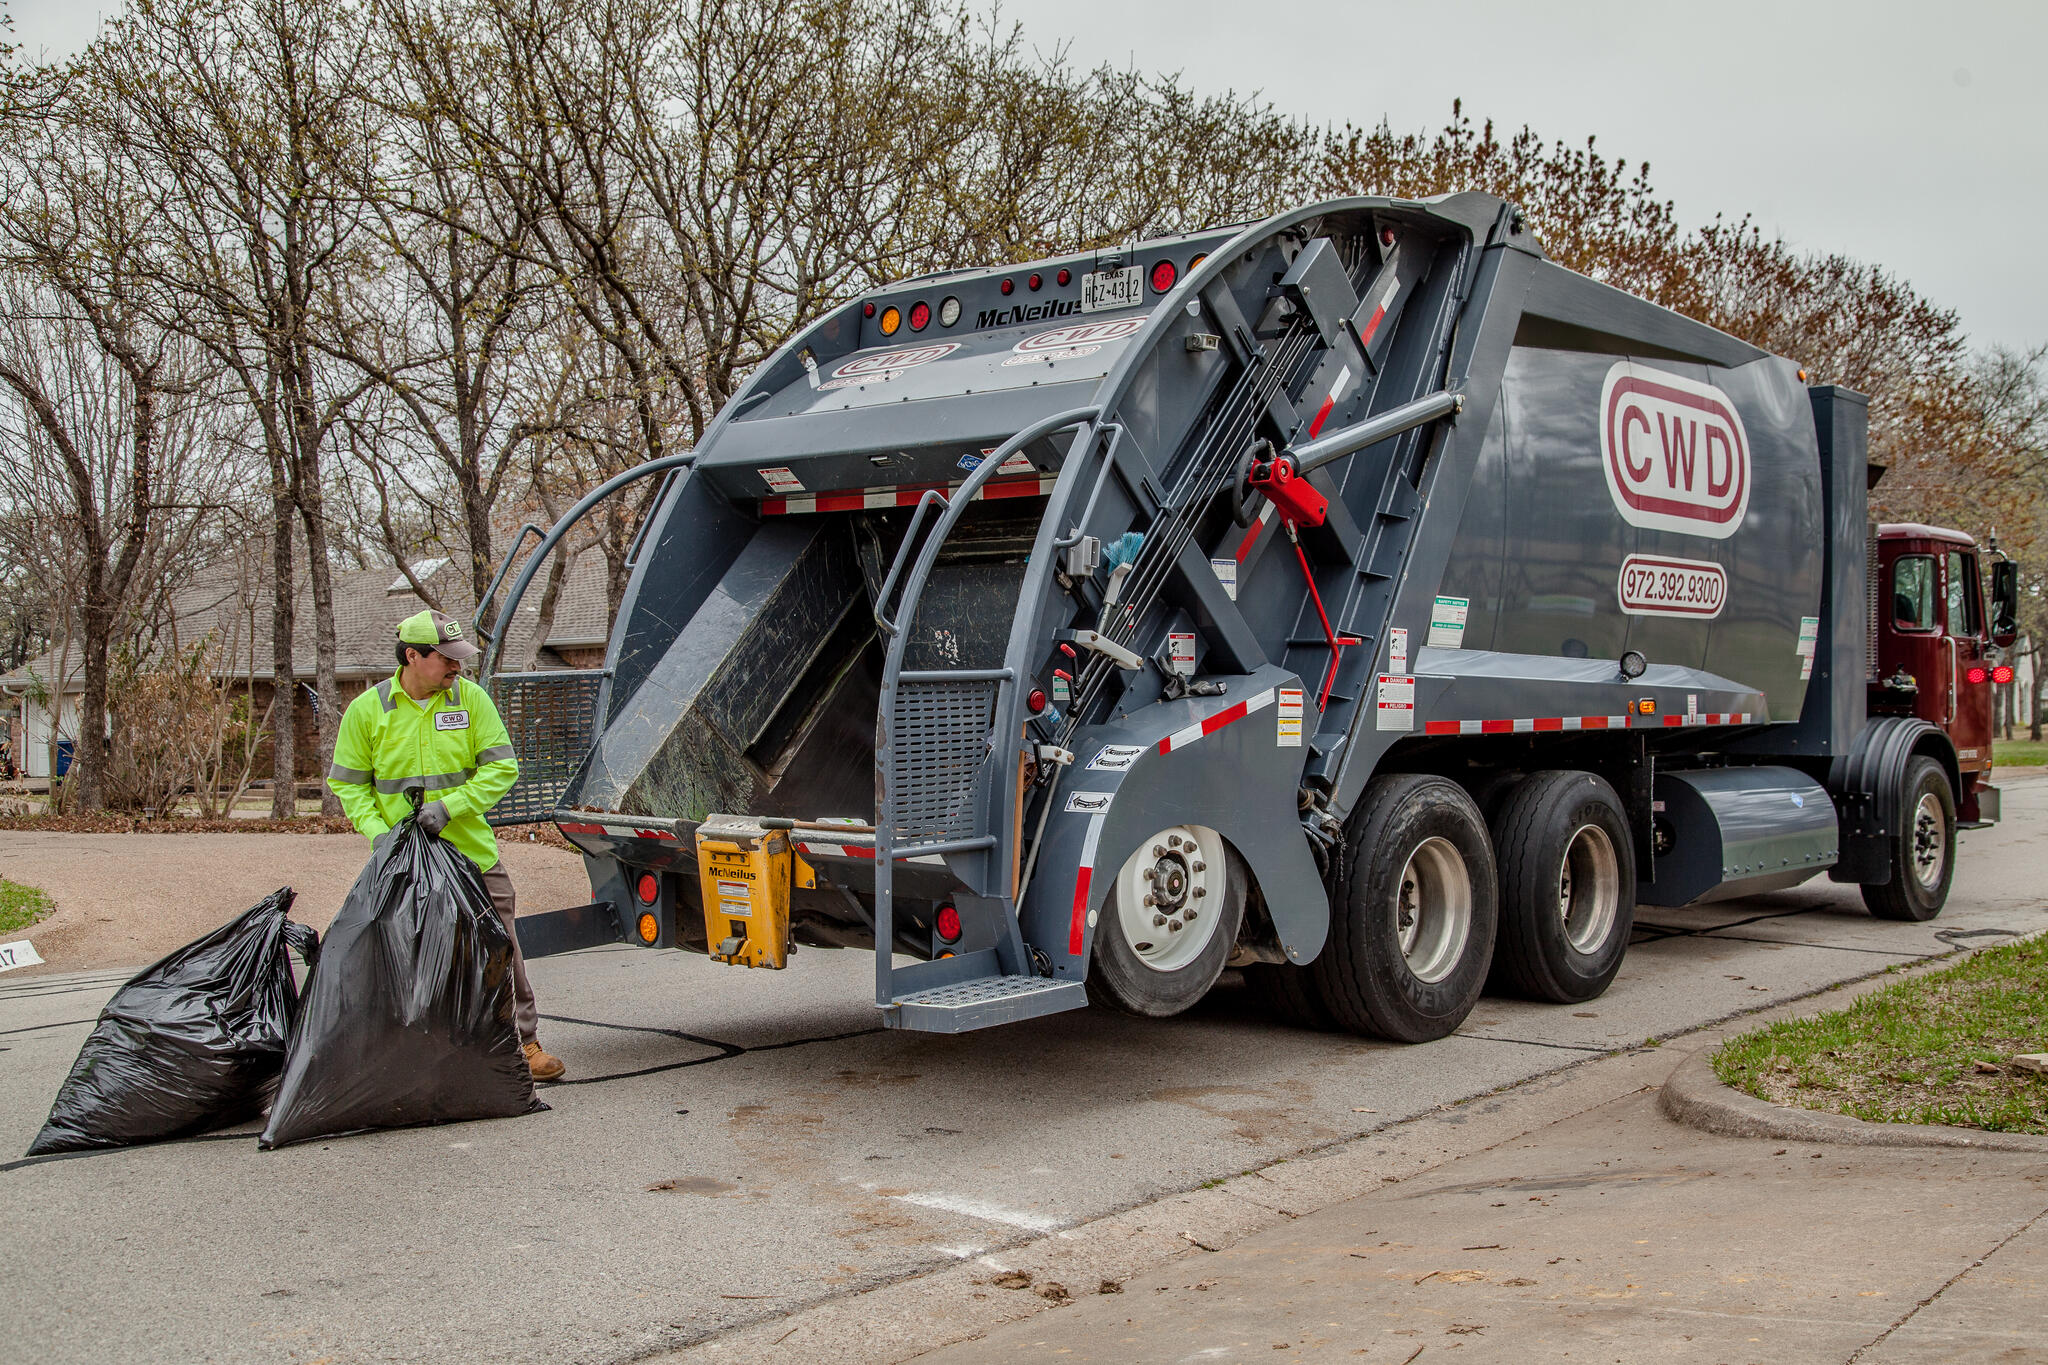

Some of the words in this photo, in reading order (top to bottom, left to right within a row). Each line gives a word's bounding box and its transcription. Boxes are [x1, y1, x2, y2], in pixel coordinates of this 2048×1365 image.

[1101, 271, 1124, 280] TEXAS
[976, 299, 1083, 329] McNeilus
[1033, 322, 1136, 345] CWD
[850, 349, 941, 370] CWD
[1622, 405, 1732, 497] CWD
[1626, 570, 1719, 604] 972.392.9300
[708, 866, 756, 880] McNeilus
